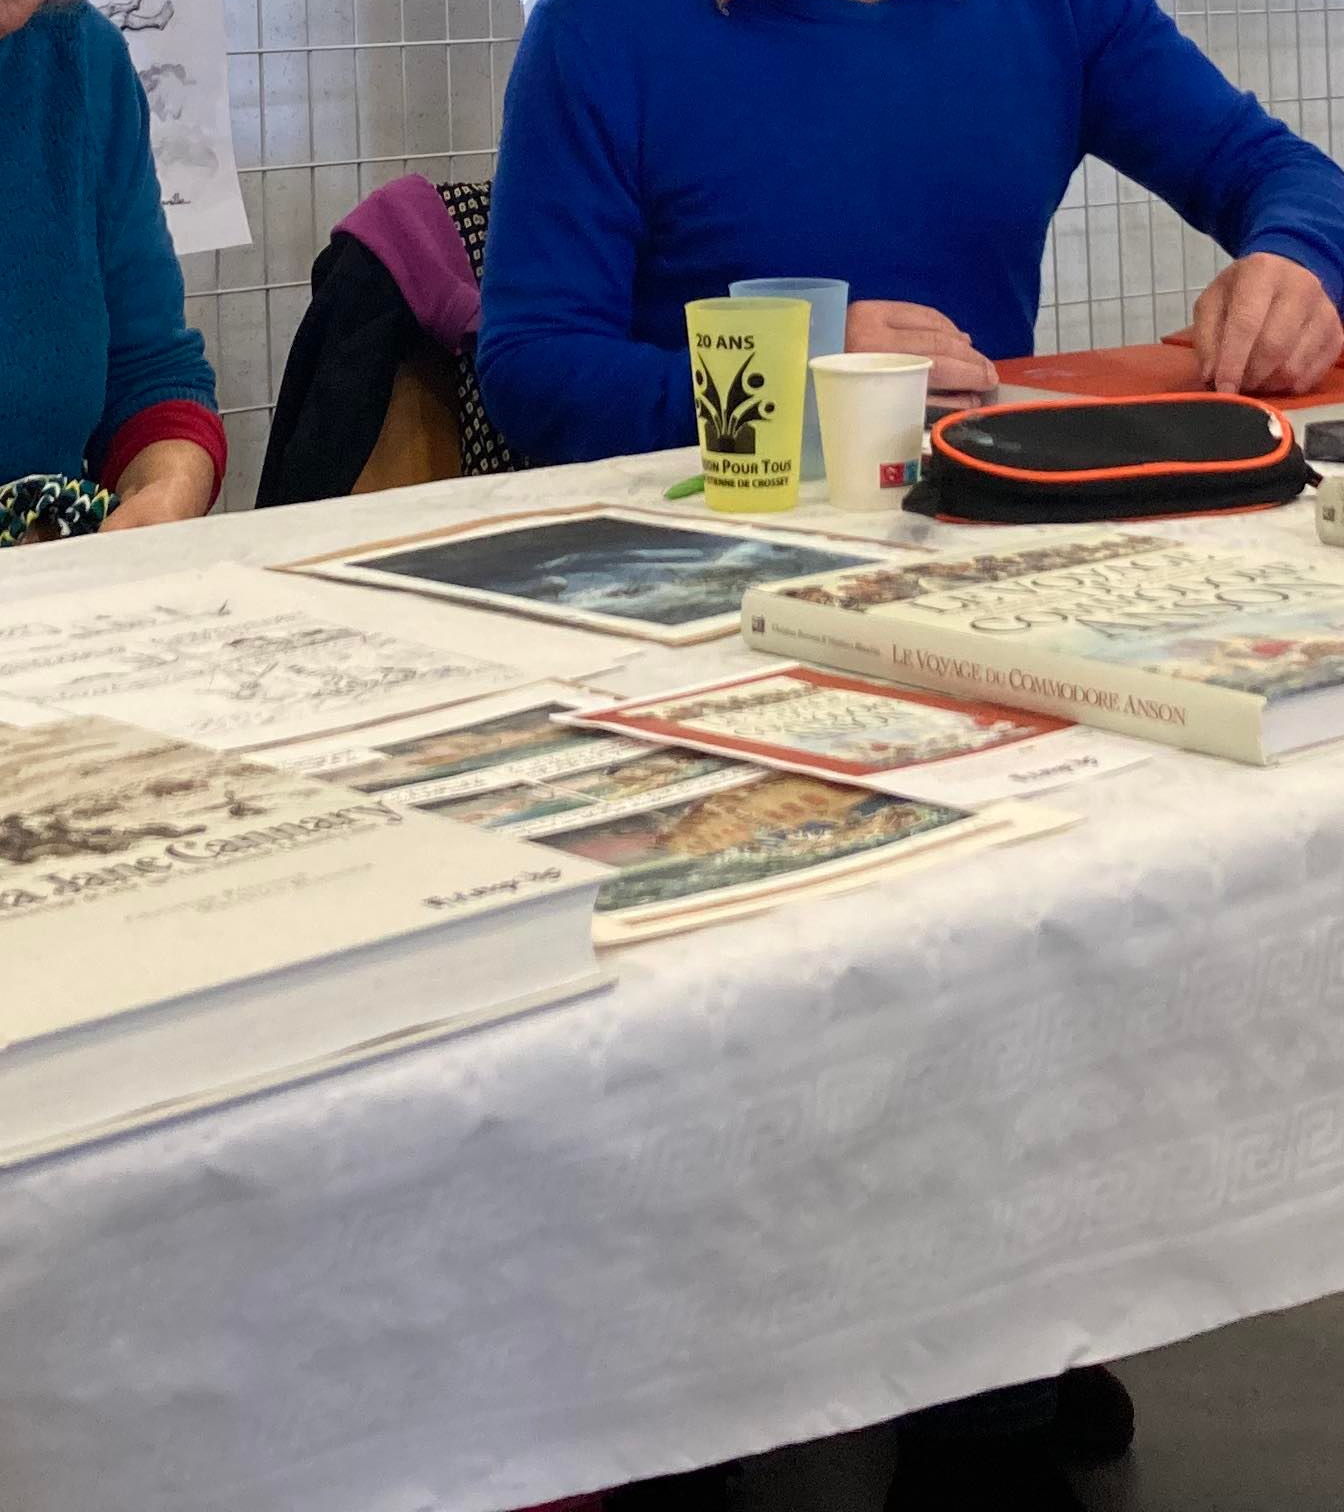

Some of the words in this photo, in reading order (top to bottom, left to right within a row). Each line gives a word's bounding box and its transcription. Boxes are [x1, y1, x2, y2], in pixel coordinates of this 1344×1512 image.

[695, 333, 713, 350] 20
[716, 334, 755, 351] ANS
[737, 478, 751, 488] DE
[891, 643, 913, 669] LE
[917, 650, 983, 683] VOYAGE
[985, 668, 1006, 684] DU
[1007, 669, 1121, 713] COMMODORE
[1124, 693, 1187, 727] ANSON
[43, 855, 173, 896] Jane
[164, 800, 403, 862] Cannary
